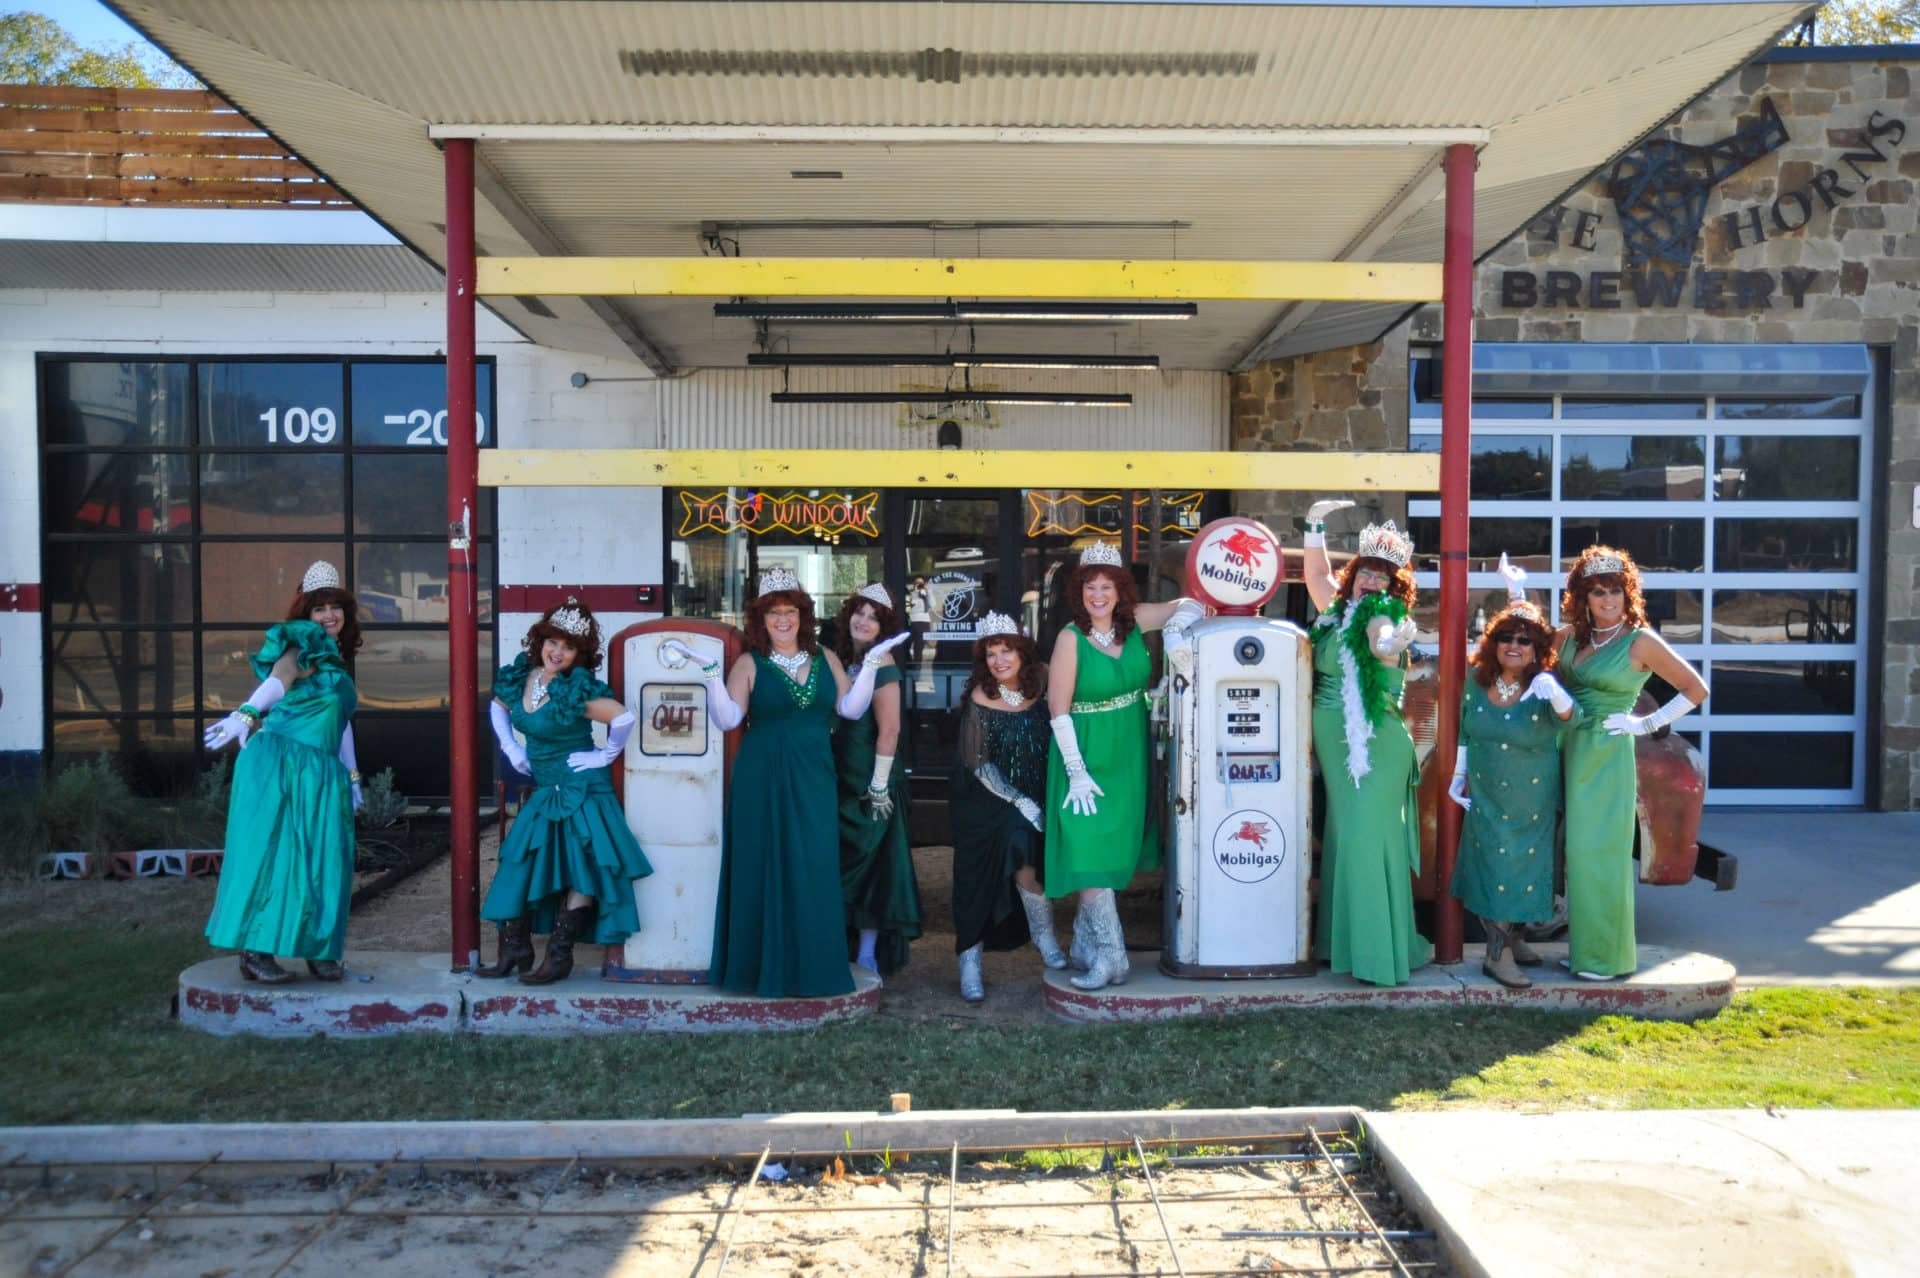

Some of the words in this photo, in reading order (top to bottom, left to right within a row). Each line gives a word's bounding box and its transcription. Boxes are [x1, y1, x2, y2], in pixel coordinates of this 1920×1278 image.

[1723, 110, 1906, 252] HORNS
[1502, 270, 1817, 309] BREWERY
[259, 407, 337, 443] 109
[693, 503, 758, 525] TACO
[773, 503, 868, 526] WINDOW
[1224, 552, 1245, 568] NO
[1201, 562, 1267, 592] Mobilgas
[652, 703, 699, 733] OUT
[1219, 852, 1280, 868] Mobilgas
